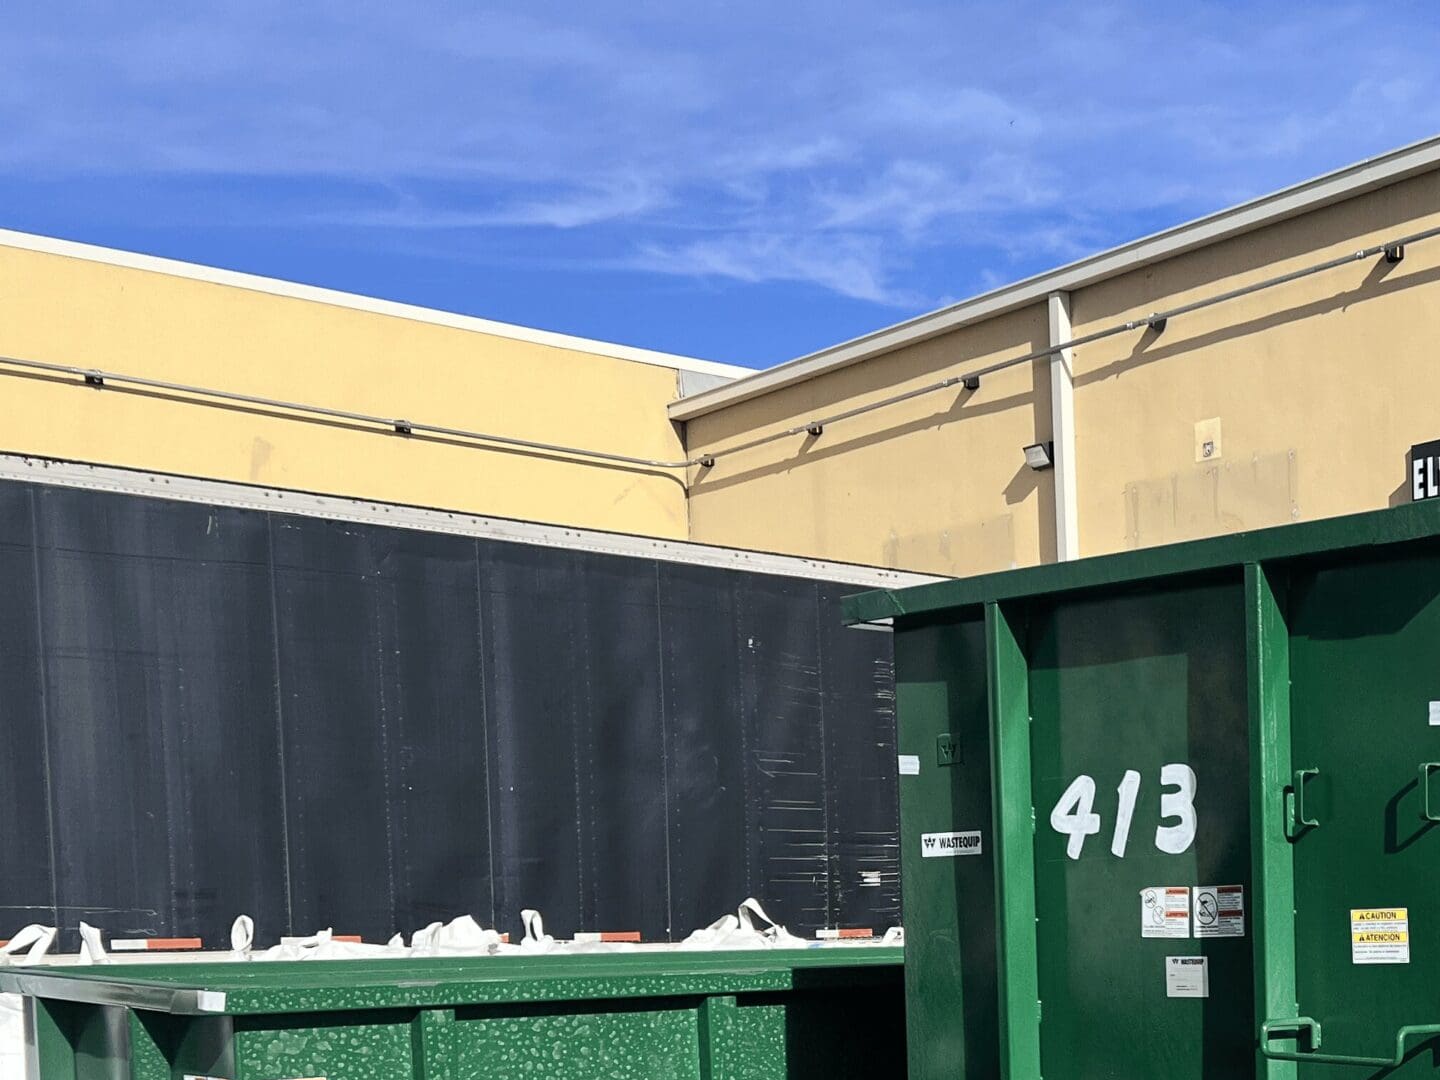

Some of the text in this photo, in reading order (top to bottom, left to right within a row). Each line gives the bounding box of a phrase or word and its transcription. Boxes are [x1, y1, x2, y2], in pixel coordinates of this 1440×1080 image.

[1412, 455, 1439, 500] EL
[1050, 763, 1198, 860] 413
[939, 835, 980, 849] WASTEQUIP
[1365, 911, 1397, 920] CAUTION
